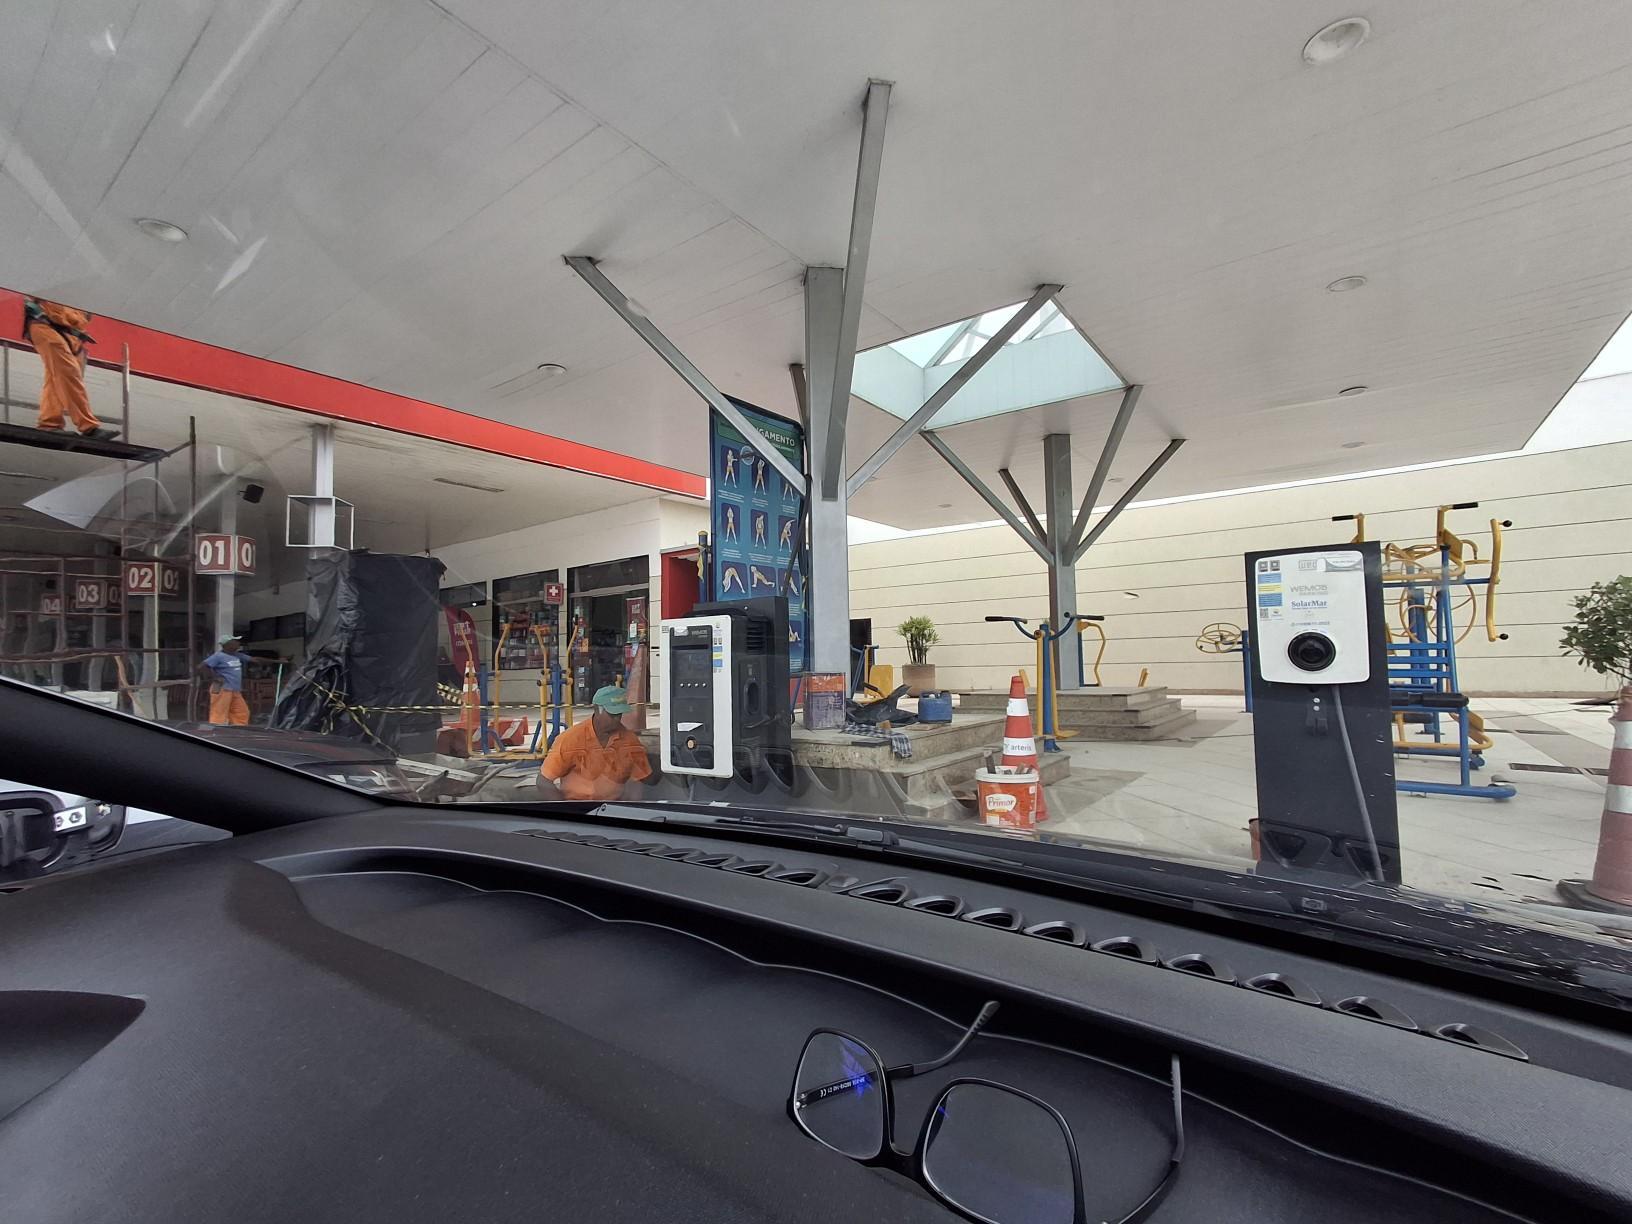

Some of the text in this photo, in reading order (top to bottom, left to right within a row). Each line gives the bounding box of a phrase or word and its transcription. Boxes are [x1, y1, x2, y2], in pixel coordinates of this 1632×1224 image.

[755, 427, 795, 446] GAMENTO
[199, 540, 225, 566] 01
[129, 567, 153, 589] 02
[79, 584, 99, 602] 03
[43, 598, 60, 613] 04
[1010, 744, 1032, 752] arteris
